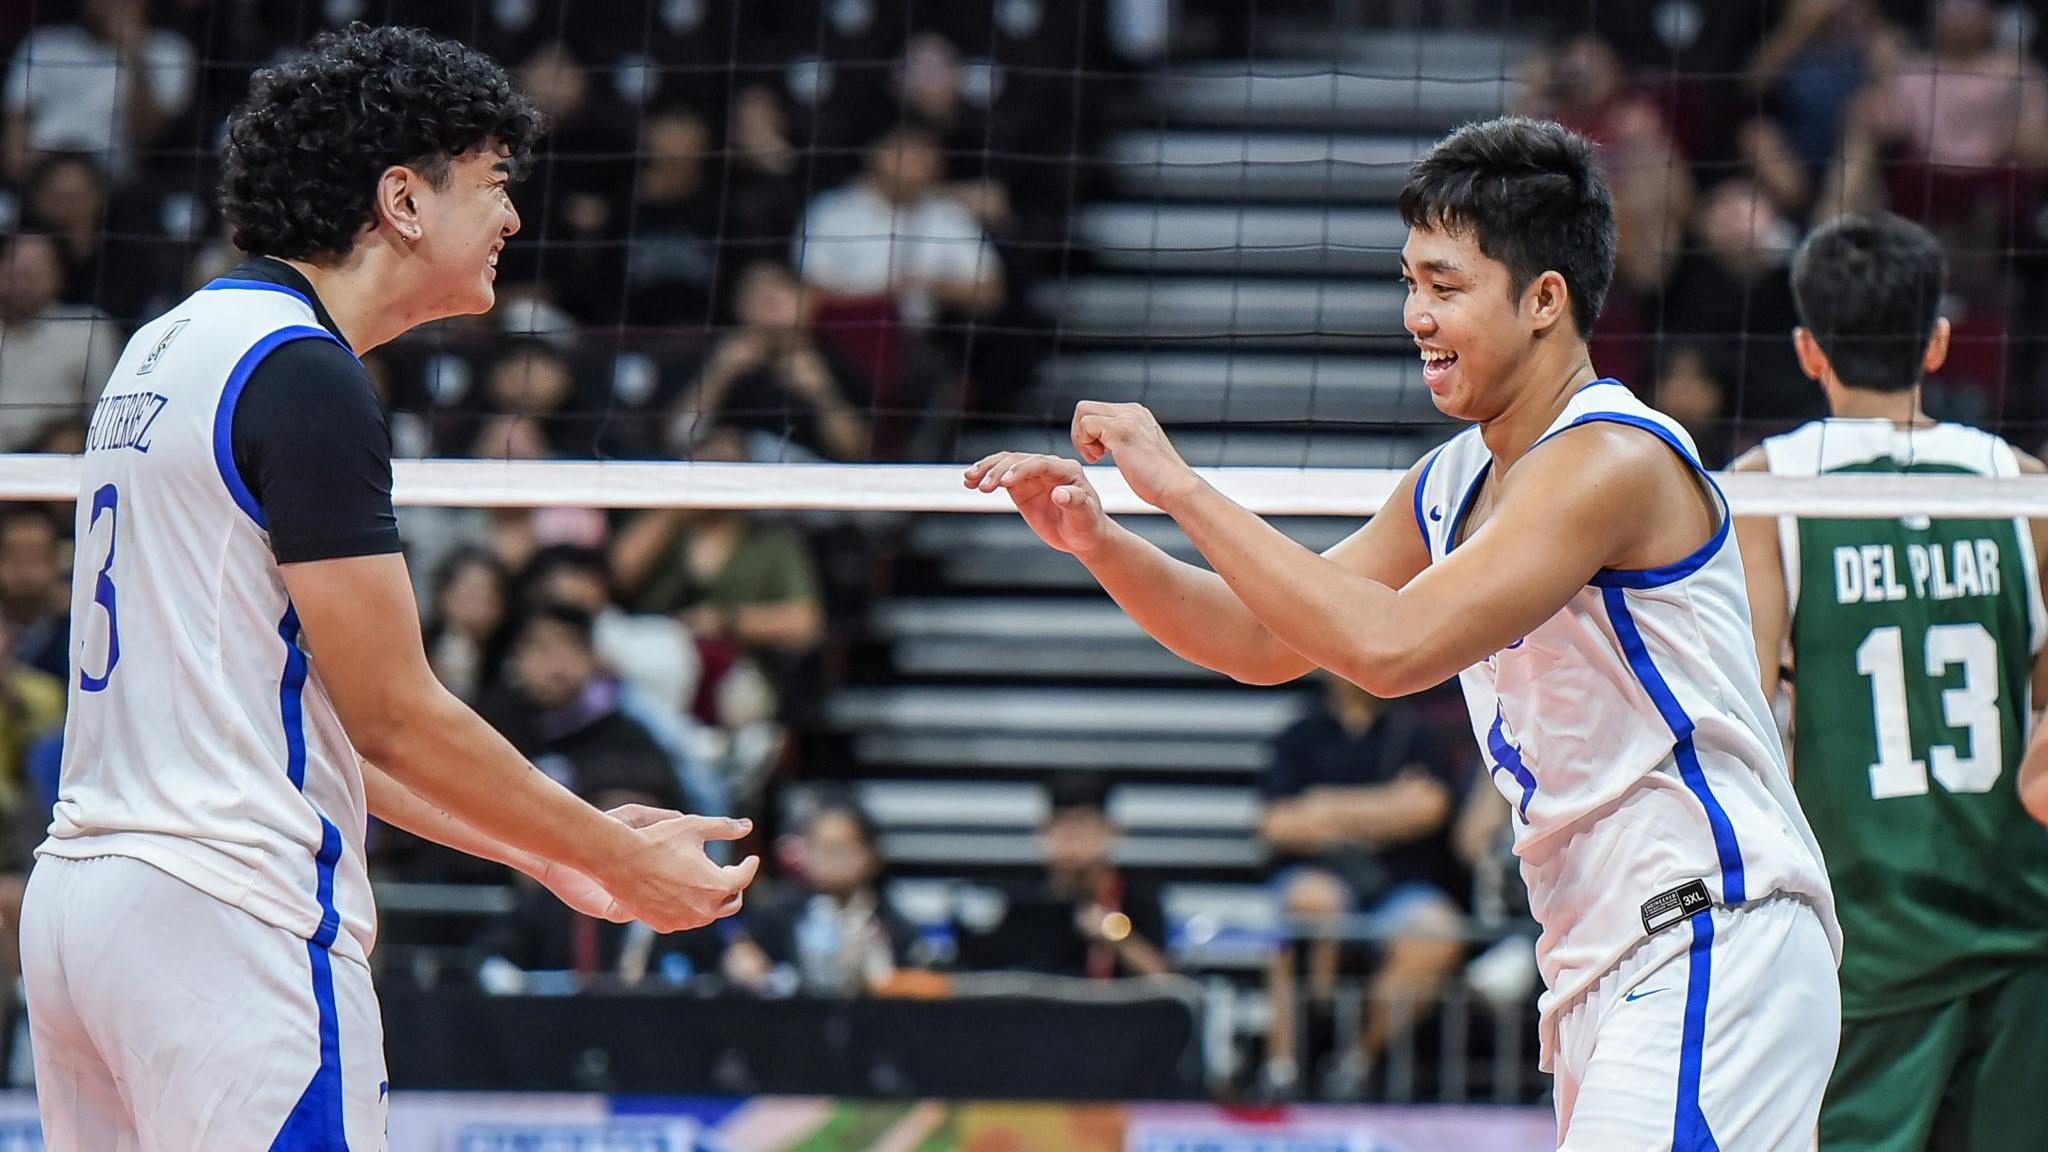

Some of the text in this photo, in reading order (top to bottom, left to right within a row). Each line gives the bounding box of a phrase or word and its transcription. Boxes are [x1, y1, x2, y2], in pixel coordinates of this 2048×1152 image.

[79, 483, 120, 692] 3
[1833, 544, 1907, 604] DEL
[1856, 622, 2003, 800] 13
[1682, 891, 1705, 906] 3XL
